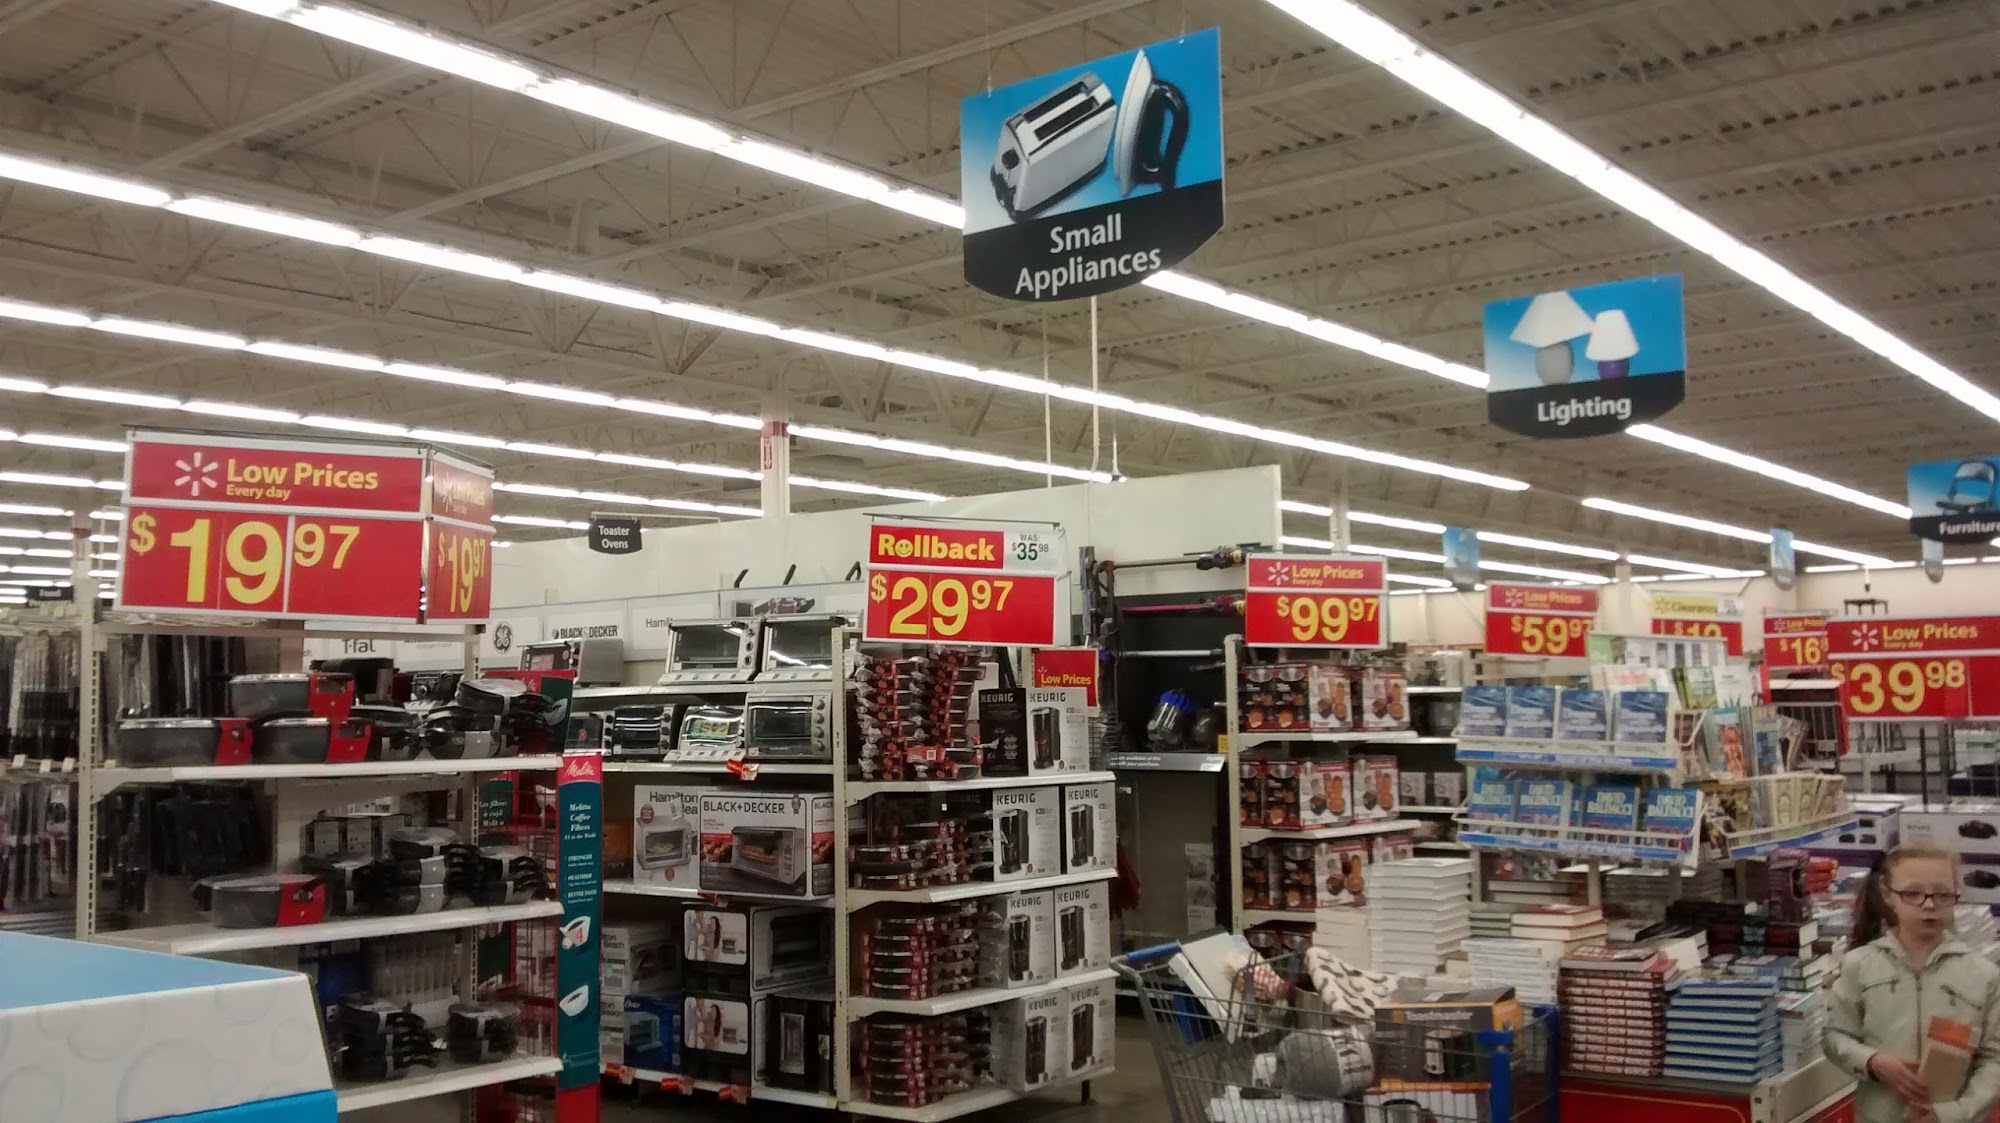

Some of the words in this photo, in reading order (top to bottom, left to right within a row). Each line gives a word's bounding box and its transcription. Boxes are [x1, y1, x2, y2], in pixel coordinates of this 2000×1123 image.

[1050, 213, 1122, 253] Small
[1015, 248, 1161, 299] Appliances
[1537, 396, 1632, 426] Lighting
[226, 458, 288, 484] Low
[294, 462, 379, 490] Prices
[226, 484, 264, 499] Every
[266, 486, 291, 502] day
[598, 525, 630, 536] Toaster
[601, 538, 629, 549] Ovens
[878, 533, 995, 561] Rollback
[1292, 565, 1320, 578] Low
[1323, 565, 1364, 579] Prices
[1883, 625, 1919, 640] Low
[1923, 623, 1978, 639] Prices
[1041, 673, 1061, 684] Low
[1063, 674, 1092, 685] Prices
[980, 693, 1014, 704] KEURIG
[1030, 692, 1066, 703] KEURIG
[996, 793, 1036, 805] KEURIG
[1068, 789, 1099, 801] KEURIG
[703, 801, 785, 814] BLACK+DECKER
[569, 813, 591, 823] Coffee
[570, 823, 591, 832] Filters
[1010, 896, 1042, 909] KEURIG
[1058, 889, 1090, 903] KEURIG
[1071, 986, 1100, 1002] KEURIG
[1028, 997, 1057, 1011] KEURIG
